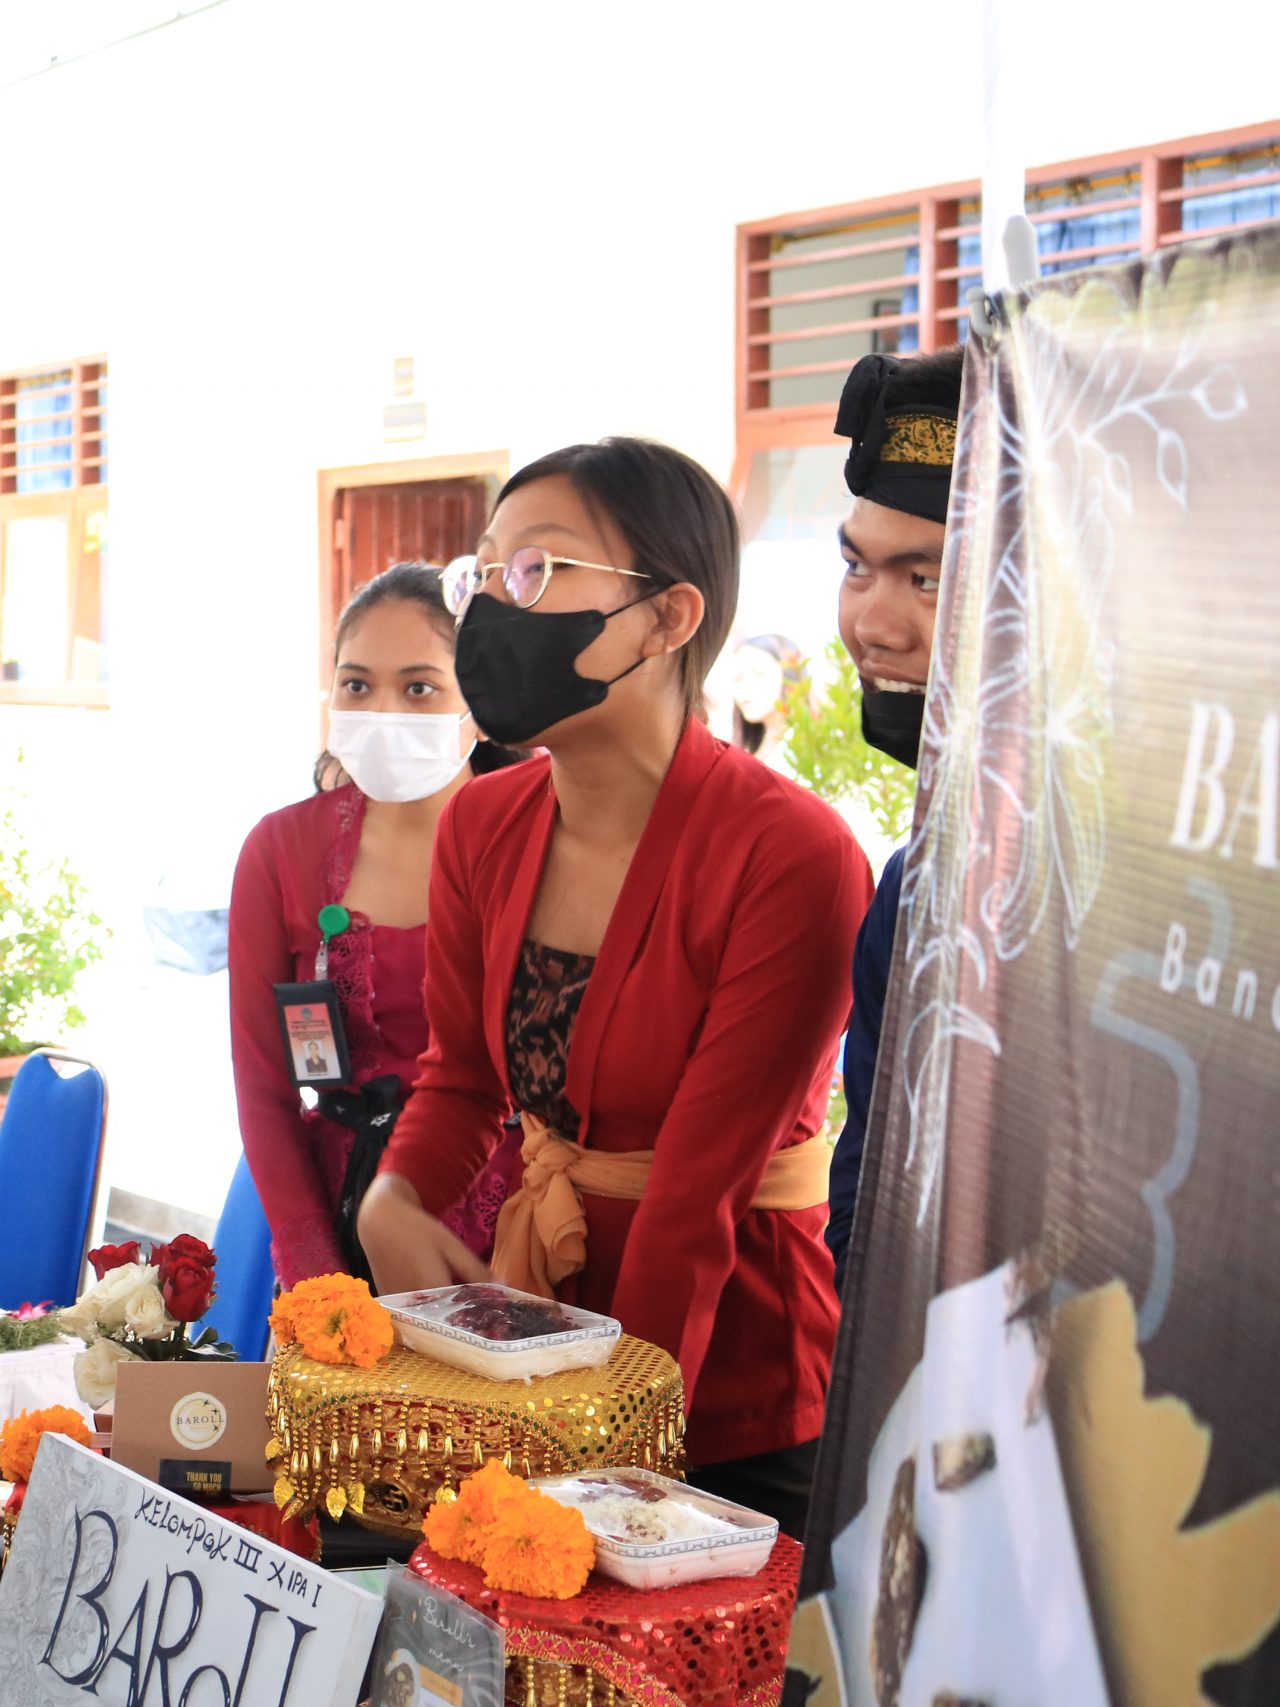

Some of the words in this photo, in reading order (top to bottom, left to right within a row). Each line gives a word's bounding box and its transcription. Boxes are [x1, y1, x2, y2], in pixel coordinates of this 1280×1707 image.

[176, 1414, 225, 1426] BAROLL
[186, 1471, 208, 1482] THANK
[209, 1473, 222, 1483] YOU
[233, 1538, 263, 1574] III
[267, 1560, 286, 1590] X
